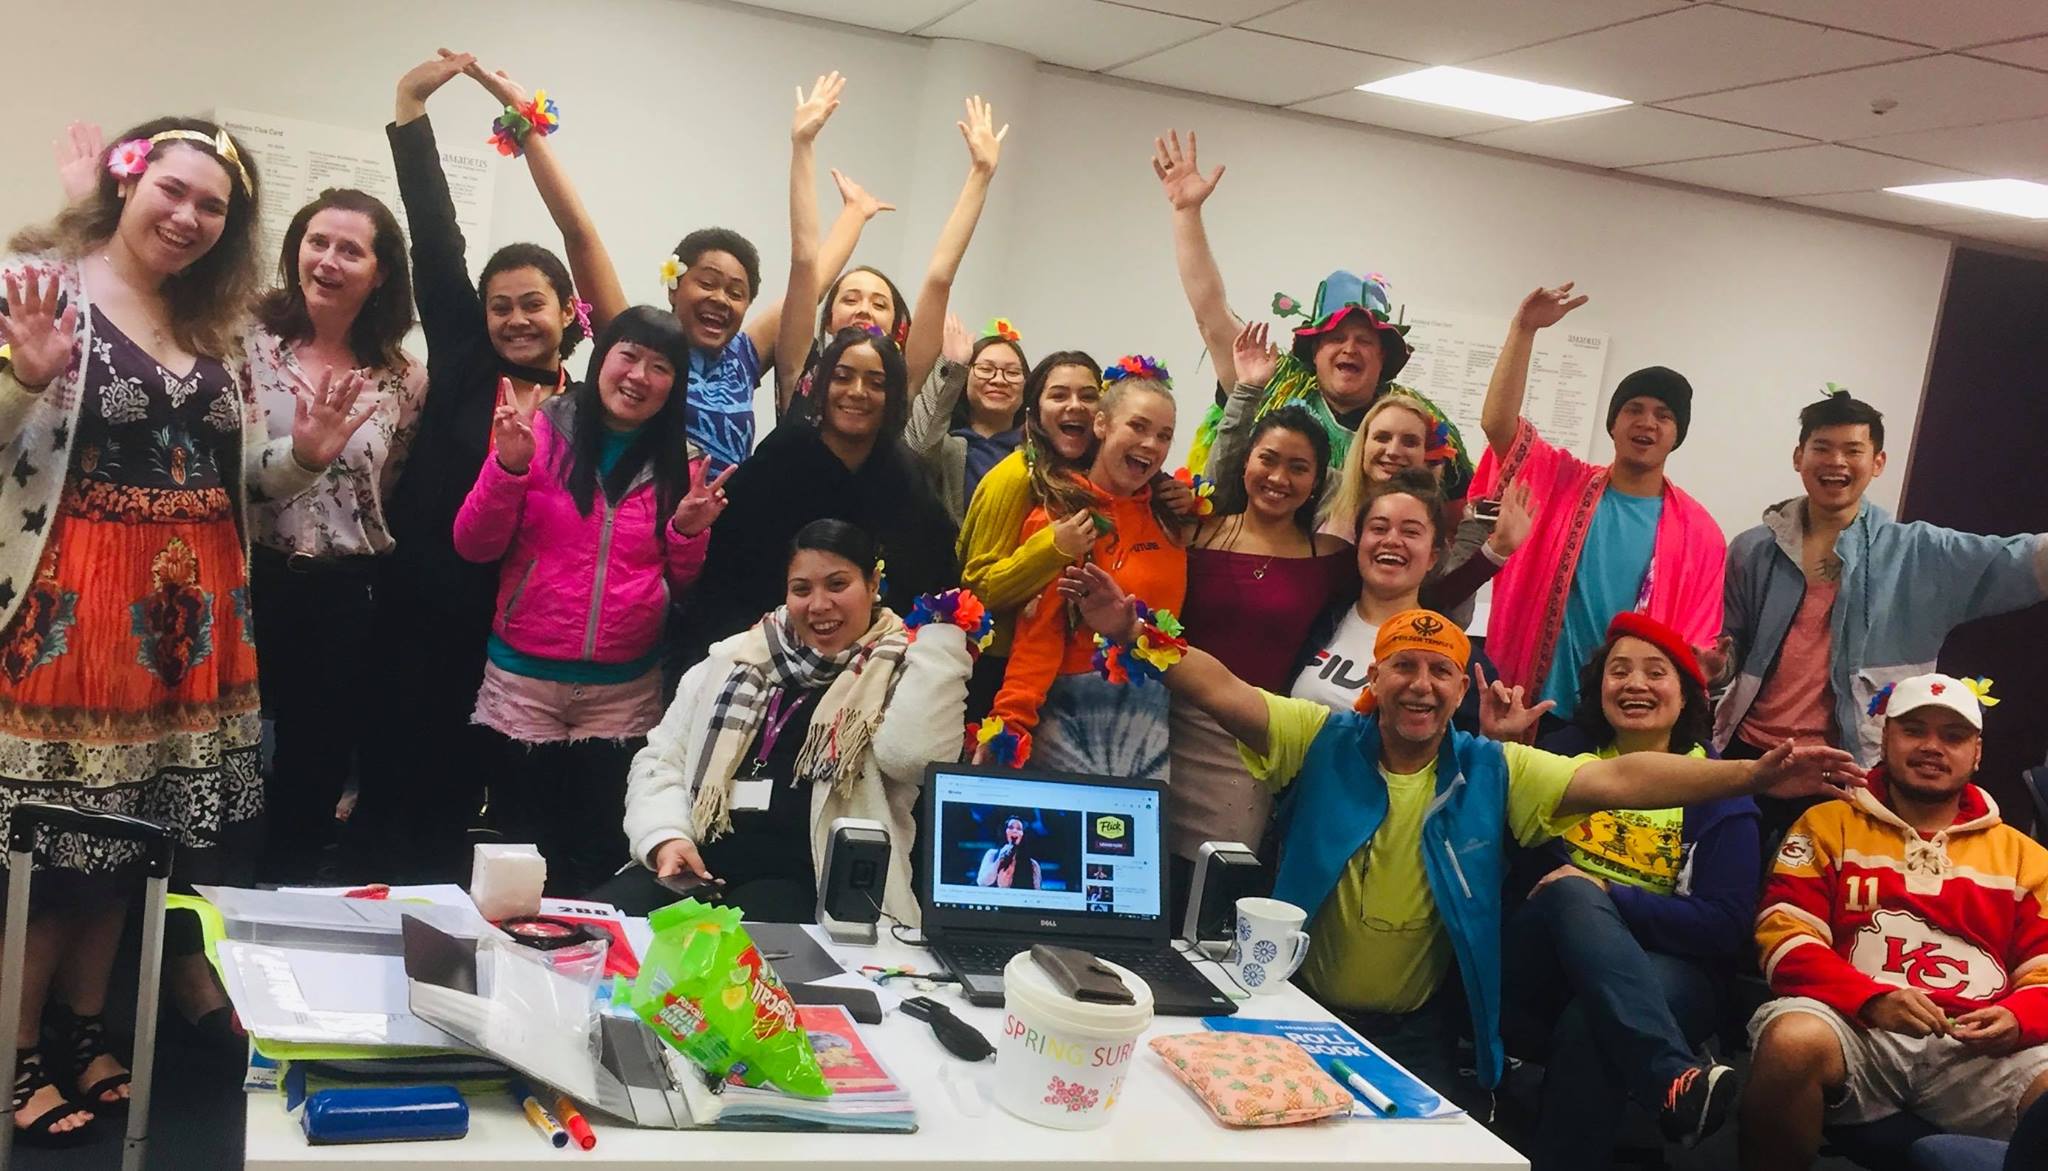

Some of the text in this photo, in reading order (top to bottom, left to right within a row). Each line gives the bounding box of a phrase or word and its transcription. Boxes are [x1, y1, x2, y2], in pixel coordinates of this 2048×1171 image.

[1099, 820, 1122, 833] Flick
[1845, 876, 1881, 911] 11
[1040, 919, 1057, 927] DELL
[1882, 935, 1970, 997] KC
[1005, 1014, 1136, 1068] SPRING SUR
[1284, 1031, 1356, 1046] ROLL
[1300, 1043, 1371, 1057] BOOK
